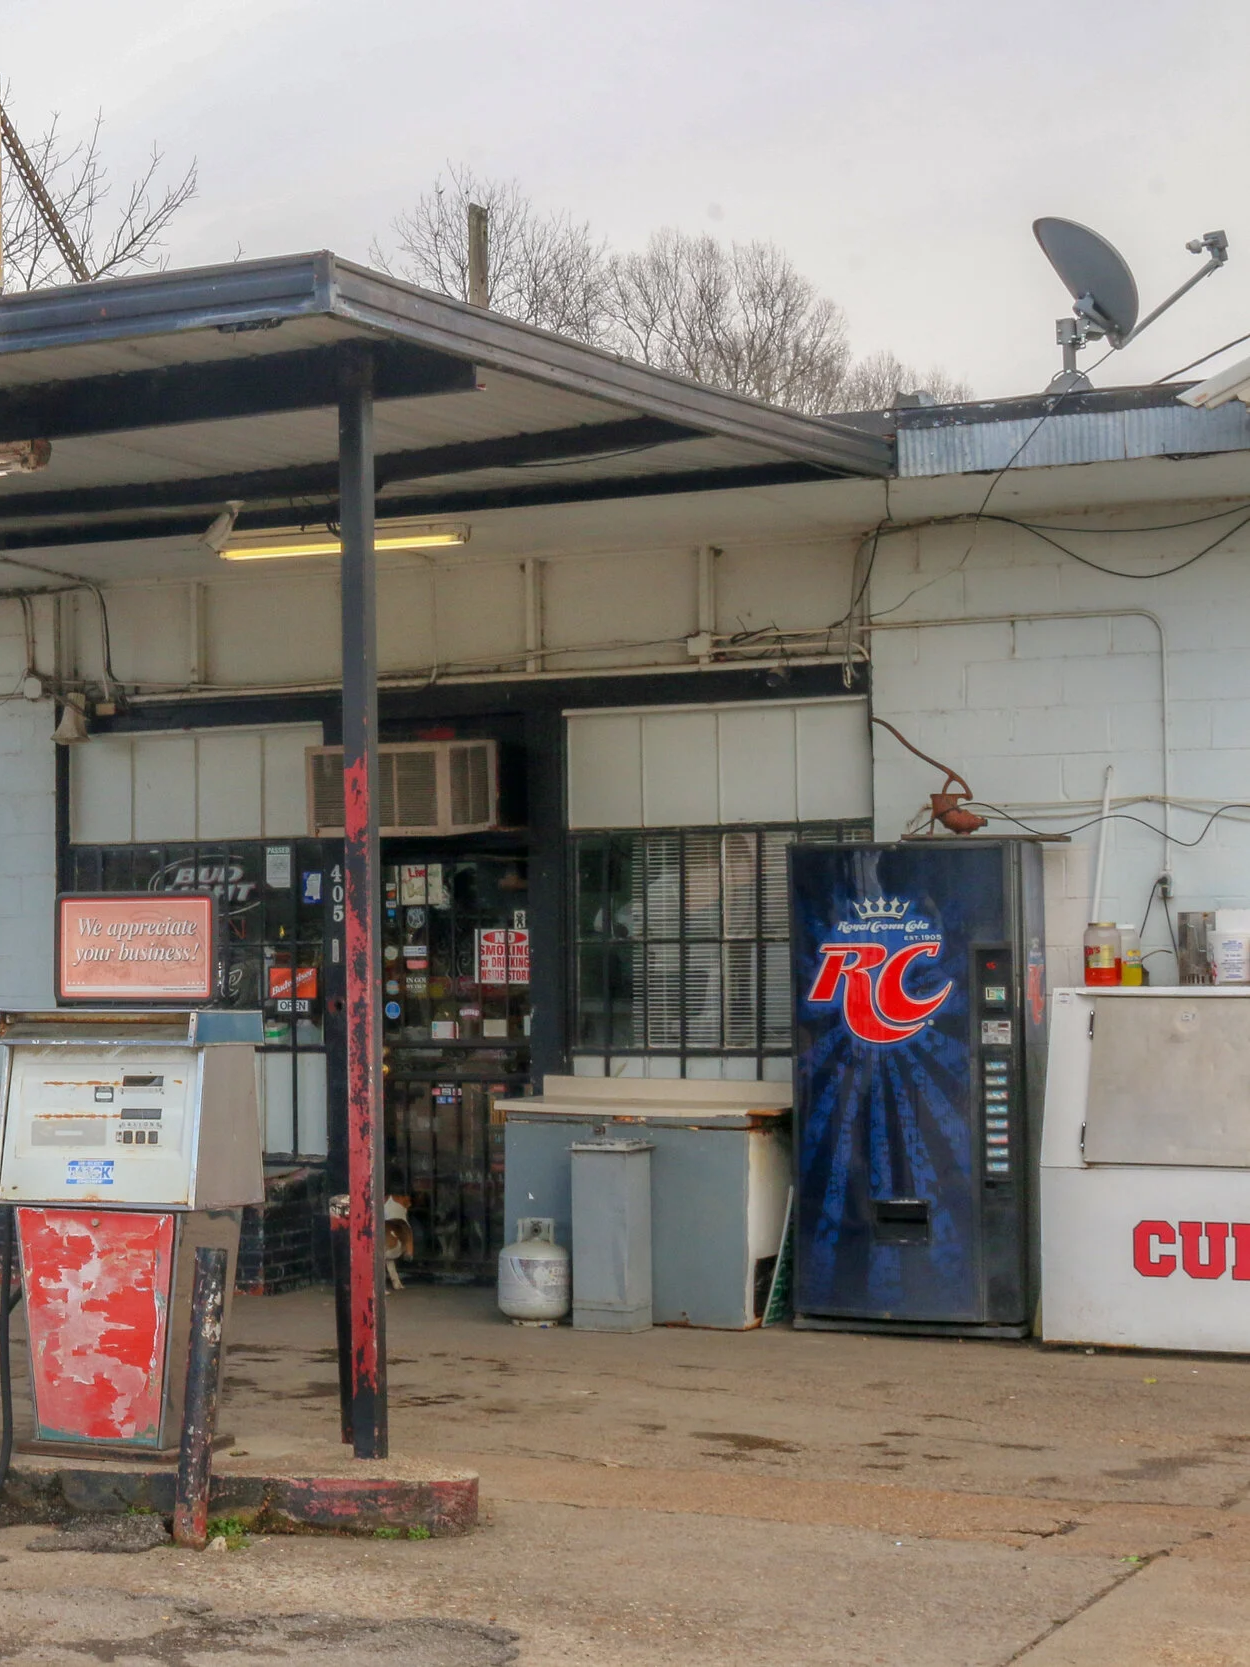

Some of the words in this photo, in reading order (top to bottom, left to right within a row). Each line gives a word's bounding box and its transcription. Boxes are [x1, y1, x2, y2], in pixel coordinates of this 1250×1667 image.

[174, 866, 244, 885] BUD
[78, 917, 102, 936] We
[107, 916, 198, 941] appreciate
[837, 921, 870, 934] Royal
[870, 920, 904, 933] Crown
[905, 920, 929, 932] Cola
[494, 932, 516, 944] NO
[72, 947, 115, 966] your
[118, 943, 200, 962] business!
[271, 968, 314, 997] Budwiser
[480, 969, 505, 980] NSIDE
[807, 942, 952, 1043] RC
